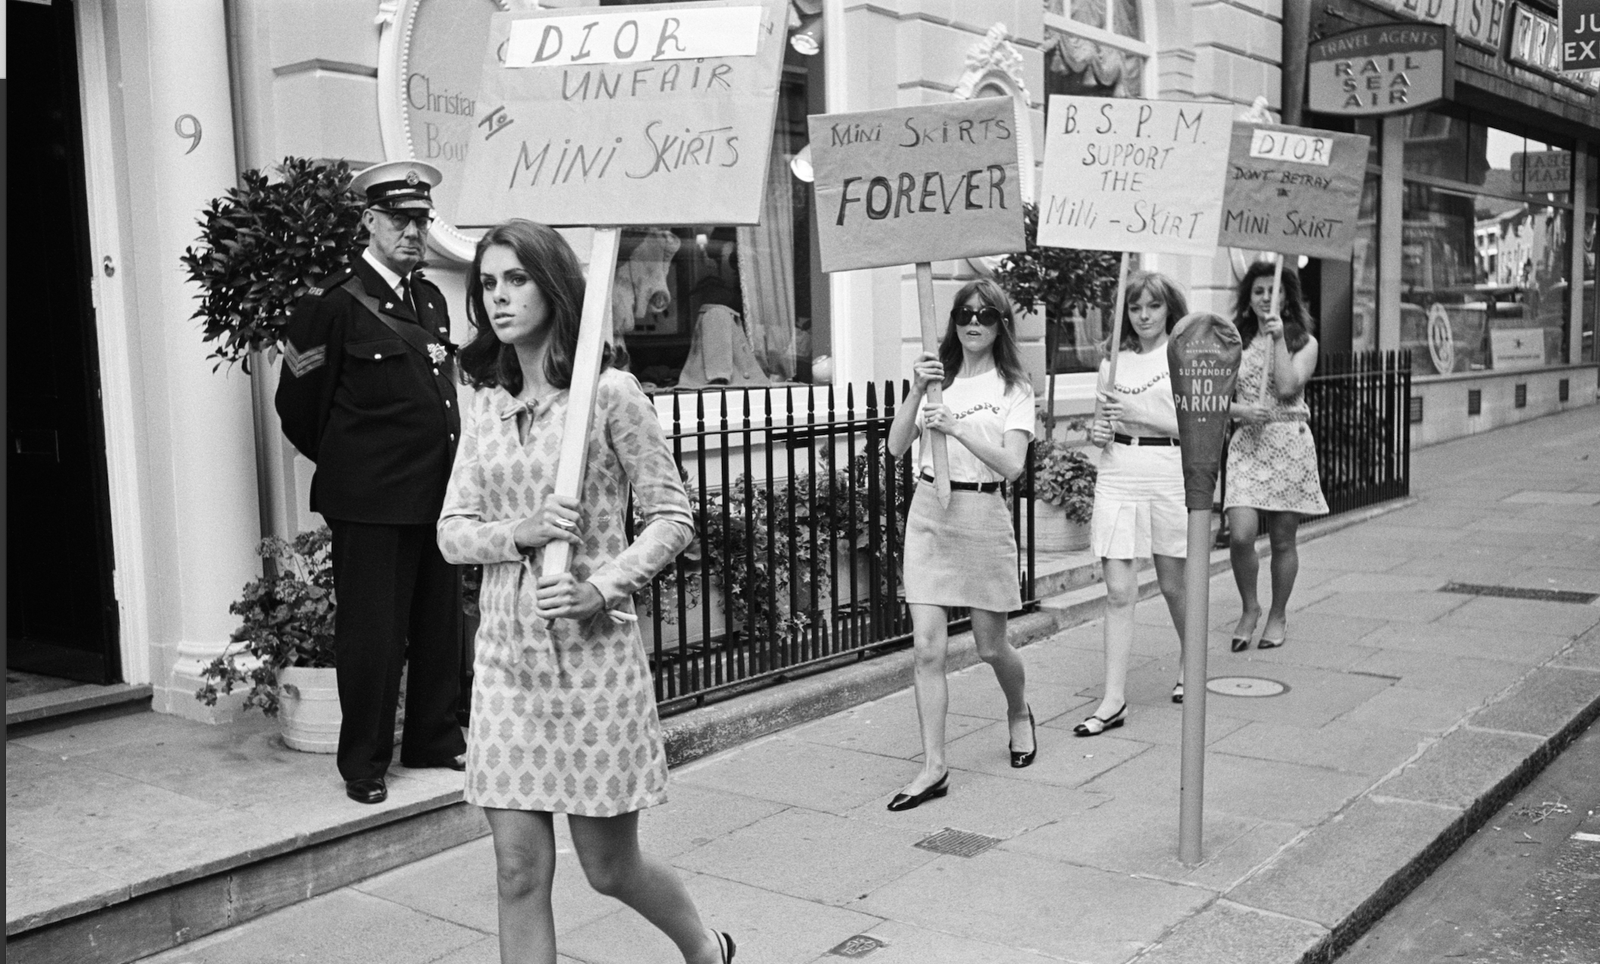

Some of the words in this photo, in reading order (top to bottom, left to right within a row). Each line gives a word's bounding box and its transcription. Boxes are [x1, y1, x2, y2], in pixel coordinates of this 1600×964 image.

[532, 17, 686, 63] DIOR
[1320, 34, 1369, 57] TRAVEL
[1379, 30, 1438, 46] AGENTS
[1335, 56, 1420, 78] RAIL
[1342, 71, 1411, 93] SEA
[1342, 87, 1408, 108] AIR
[174, 113, 202, 155] 9
[1082, 143, 1175, 170] SUPPORT
[1258, 134, 1324, 161] DIOR
[1101, 170, 1145, 192] THE
[1280, 171, 1332, 190] BETRAY
[836, 164, 1008, 226] FOREVER
[1179, 368, 1231, 376] SUSPENDED
[1192, 379, 1213, 395] NO
[1174, 393, 1232, 412] PARKIN
